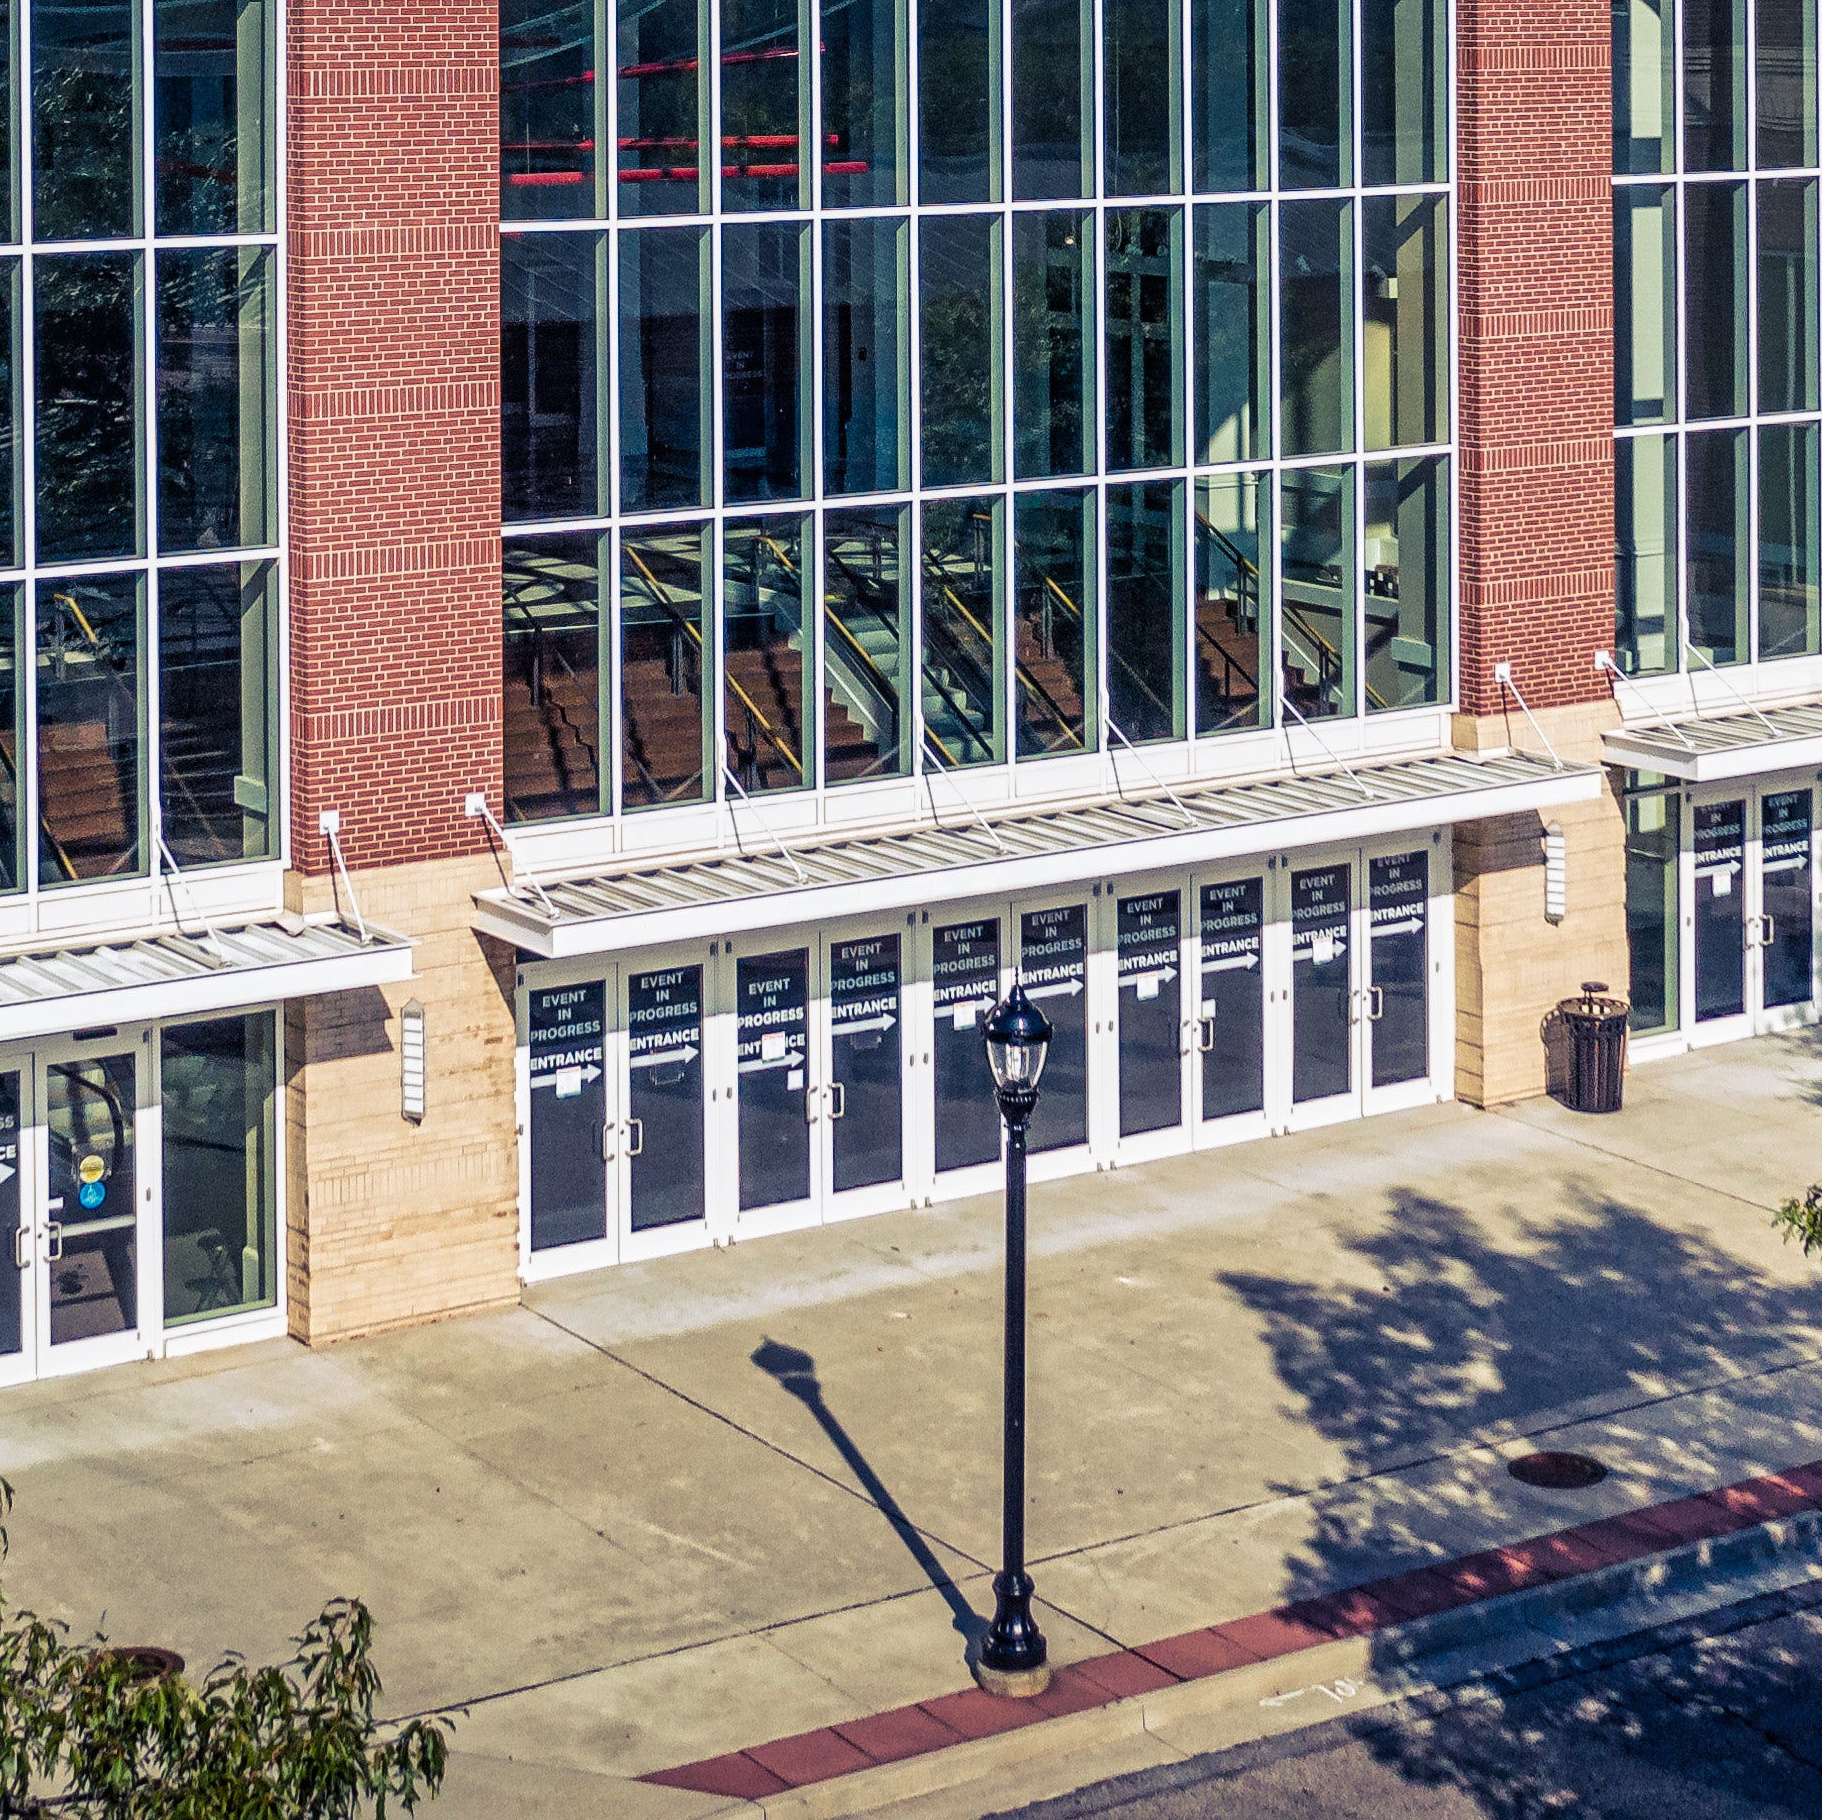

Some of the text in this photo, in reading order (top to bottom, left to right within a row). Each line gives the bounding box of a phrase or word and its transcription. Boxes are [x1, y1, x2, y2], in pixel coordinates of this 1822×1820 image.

[1377, 853, 1410, 868] EVENT
[1299, 874, 1335, 890] EVENT
[1389, 868, 1400, 879] IN
[1209, 885, 1246, 901] EVENT
[1311, 890, 1323, 902] IN
[1127, 897, 1164, 914] EVENT
[1222, 901, 1234, 913] IN
[1031, 909, 1071, 927] EVENT
[1140, 914, 1152, 925] IN
[1201, 913, 1257, 931] PROGRESS
[944, 925, 984, 943] EVENT
[1045, 926, 1057, 938] IN
[1118, 925, 1176, 945] PROGRESS
[841, 942, 883, 960] EVENT
[957, 942, 970, 955] IN
[1021, 937, 1082, 958] PROGRESS
[1201, 936, 1259, 957] ENTRANCE
[855, 959, 868, 971] IN
[933, 954, 996, 975] PROGRESS
[1118, 950, 1178, 971] ENTRANCE
[641, 971, 684, 989] EVENT
[831, 971, 895, 991] PROGRESS
[1021, 962, 1084, 985] ENTRANCE
[748, 977, 791, 995] EVENT
[933, 979, 997, 1001] ENTRANCE
[542, 990, 586, 1008] EVENT
[656, 990, 670, 1003] IN
[763, 995, 776, 1008] IN
[557, 1008, 571, 1021] IN
[629, 1002, 698, 1023] PROGRESS
[831, 996, 897, 1019] ENTRANCE
[737, 1006, 804, 1029] PROGRESS
[530, 1020, 601, 1042] PROGRESS
[629, 1027, 699, 1051] ENTRANCE
[738, 1033, 805, 1056] ENTCE
[530, 1047, 602, 1070] ENTRANCE
